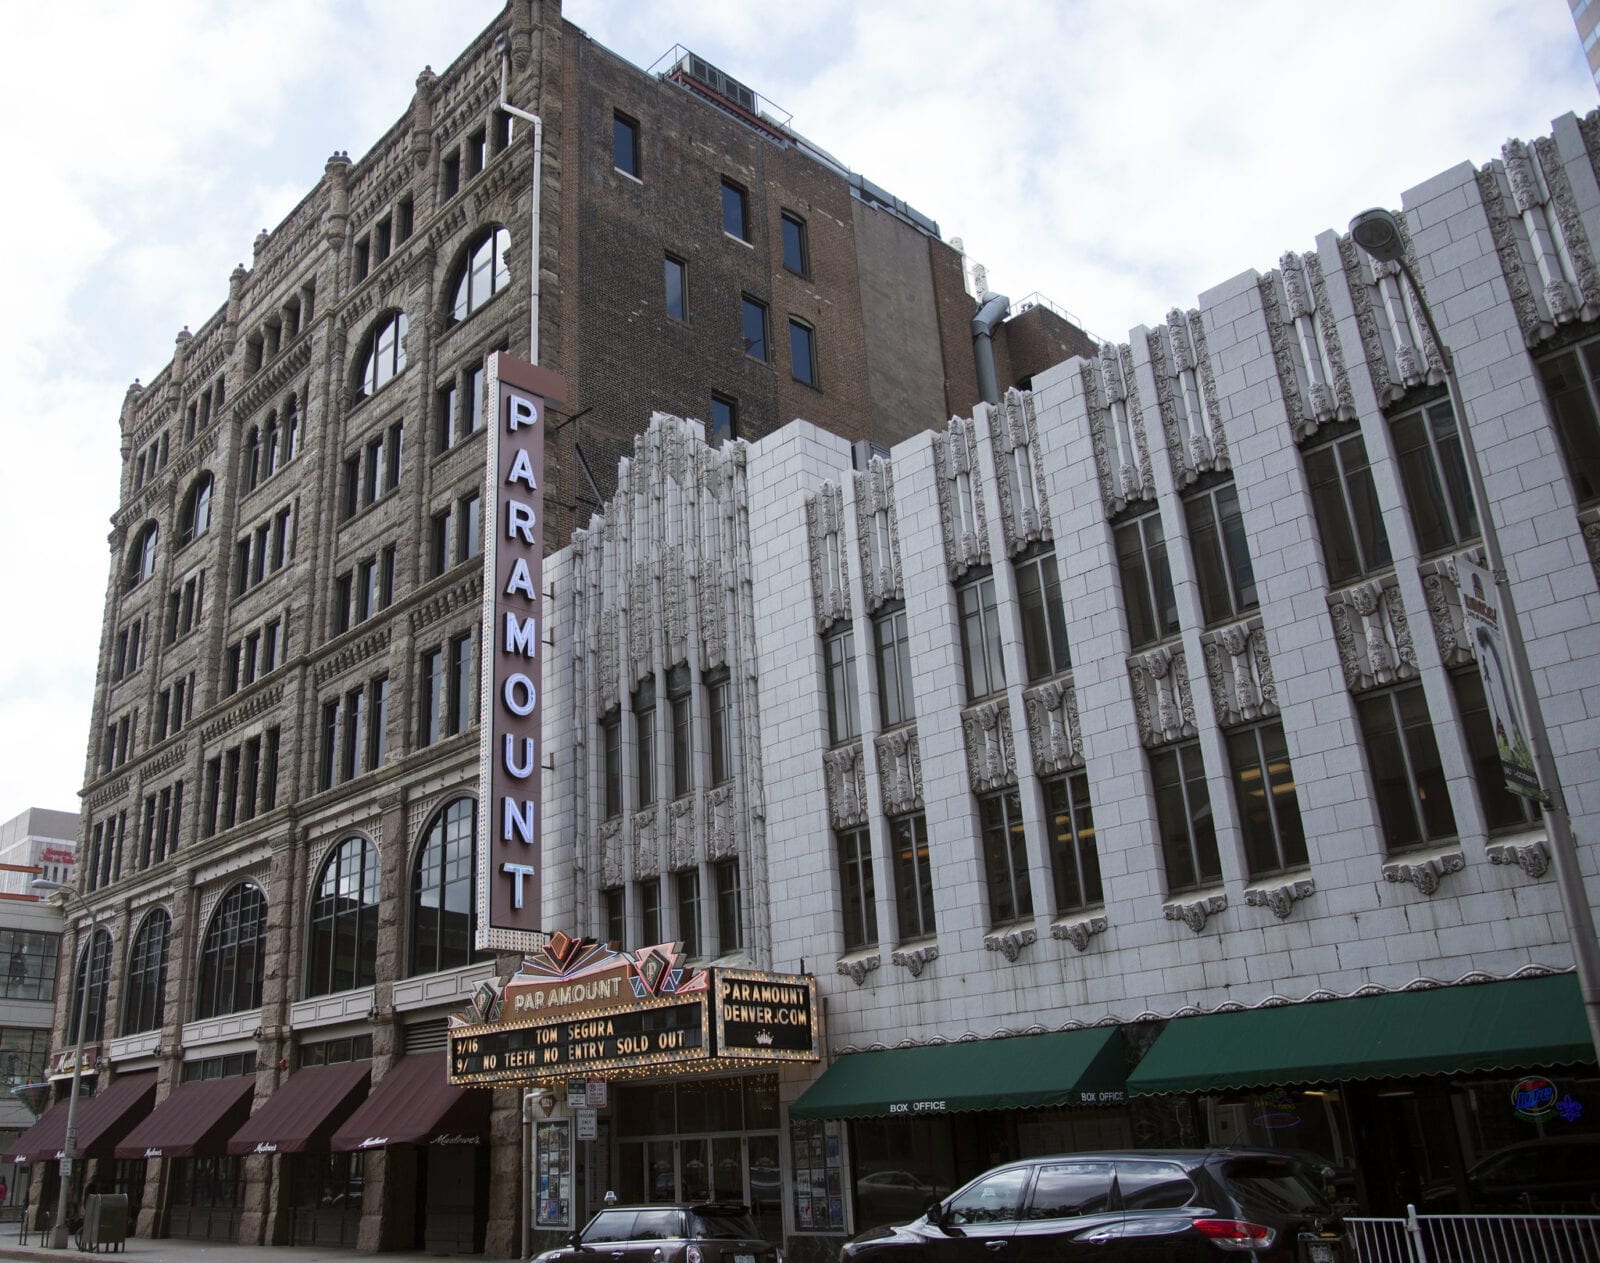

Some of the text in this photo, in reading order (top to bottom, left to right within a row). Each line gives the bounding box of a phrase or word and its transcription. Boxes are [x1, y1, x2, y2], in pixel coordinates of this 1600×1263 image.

[503, 394, 537, 909] PARAMOUNT
[514, 976, 623, 1013] PARAMOUNT
[722, 982, 804, 1005] PARAMOUNT
[724, 1004, 807, 1026] DENVER.COM
[457, 1020, 614, 1055] 9/16 TOM SEGURA
[483, 1055, 497, 1070] NO
[504, 1049, 535, 1067] TEETH
[544, 1047, 559, 1063] NO
[568, 1041, 605, 1061] ENTRY
[616, 1035, 648, 1055] SOLD
[658, 1030, 685, 1049] OUT
[889, 1101, 946, 1113] BOX OFFICE
[1081, 1091, 1124, 1102] BOX OFFICE
